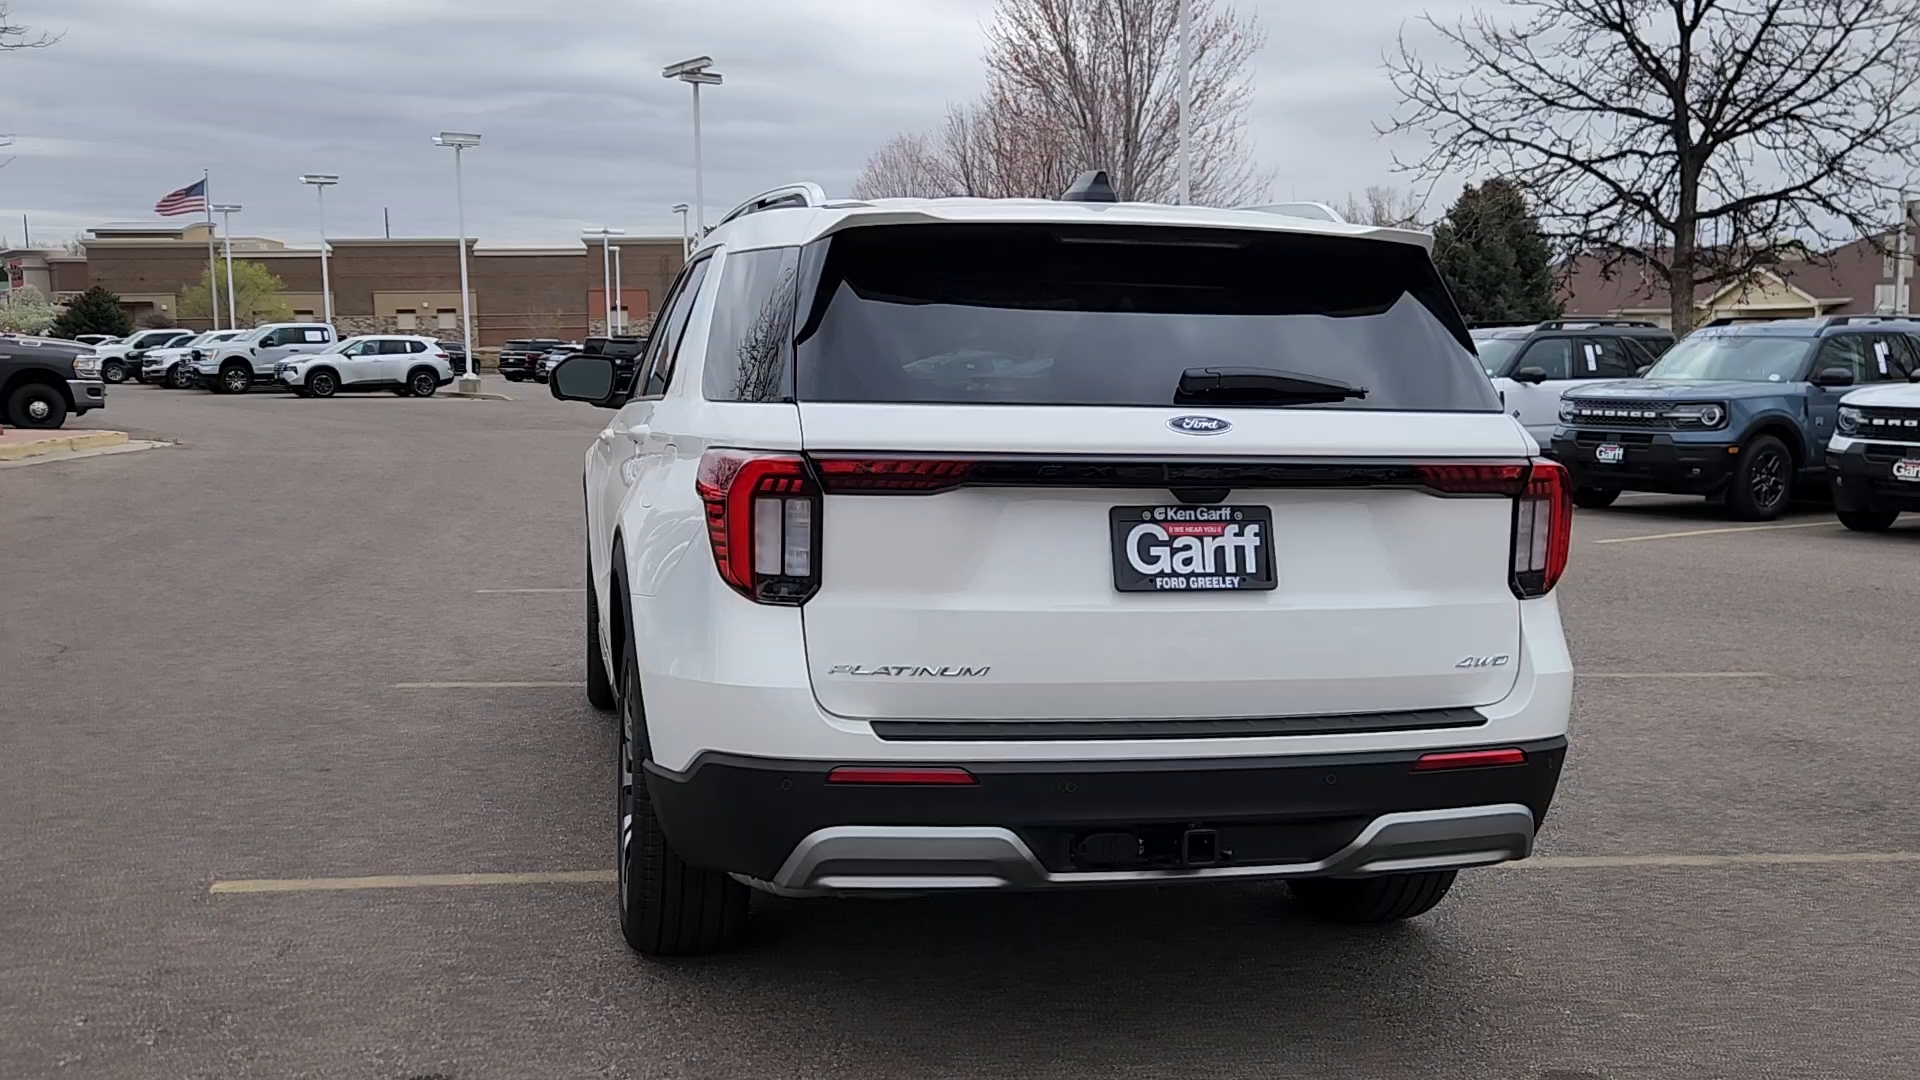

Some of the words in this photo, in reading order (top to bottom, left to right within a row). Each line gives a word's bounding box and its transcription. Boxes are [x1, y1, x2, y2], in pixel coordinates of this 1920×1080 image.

[1581, 409, 1656, 418] BRONCO
[1182, 418, 1218, 429] Ford
[1167, 507, 1195, 520] Ken
[1196, 507, 1232, 520] Garff
[1126, 523, 1260, 575] Garff
[1156, 577, 1187, 589] FORD
[1189, 576, 1240, 588] GREELEY
[1455, 655, 1509, 668] 4WD
[828, 664, 991, 677] PLATINUM
